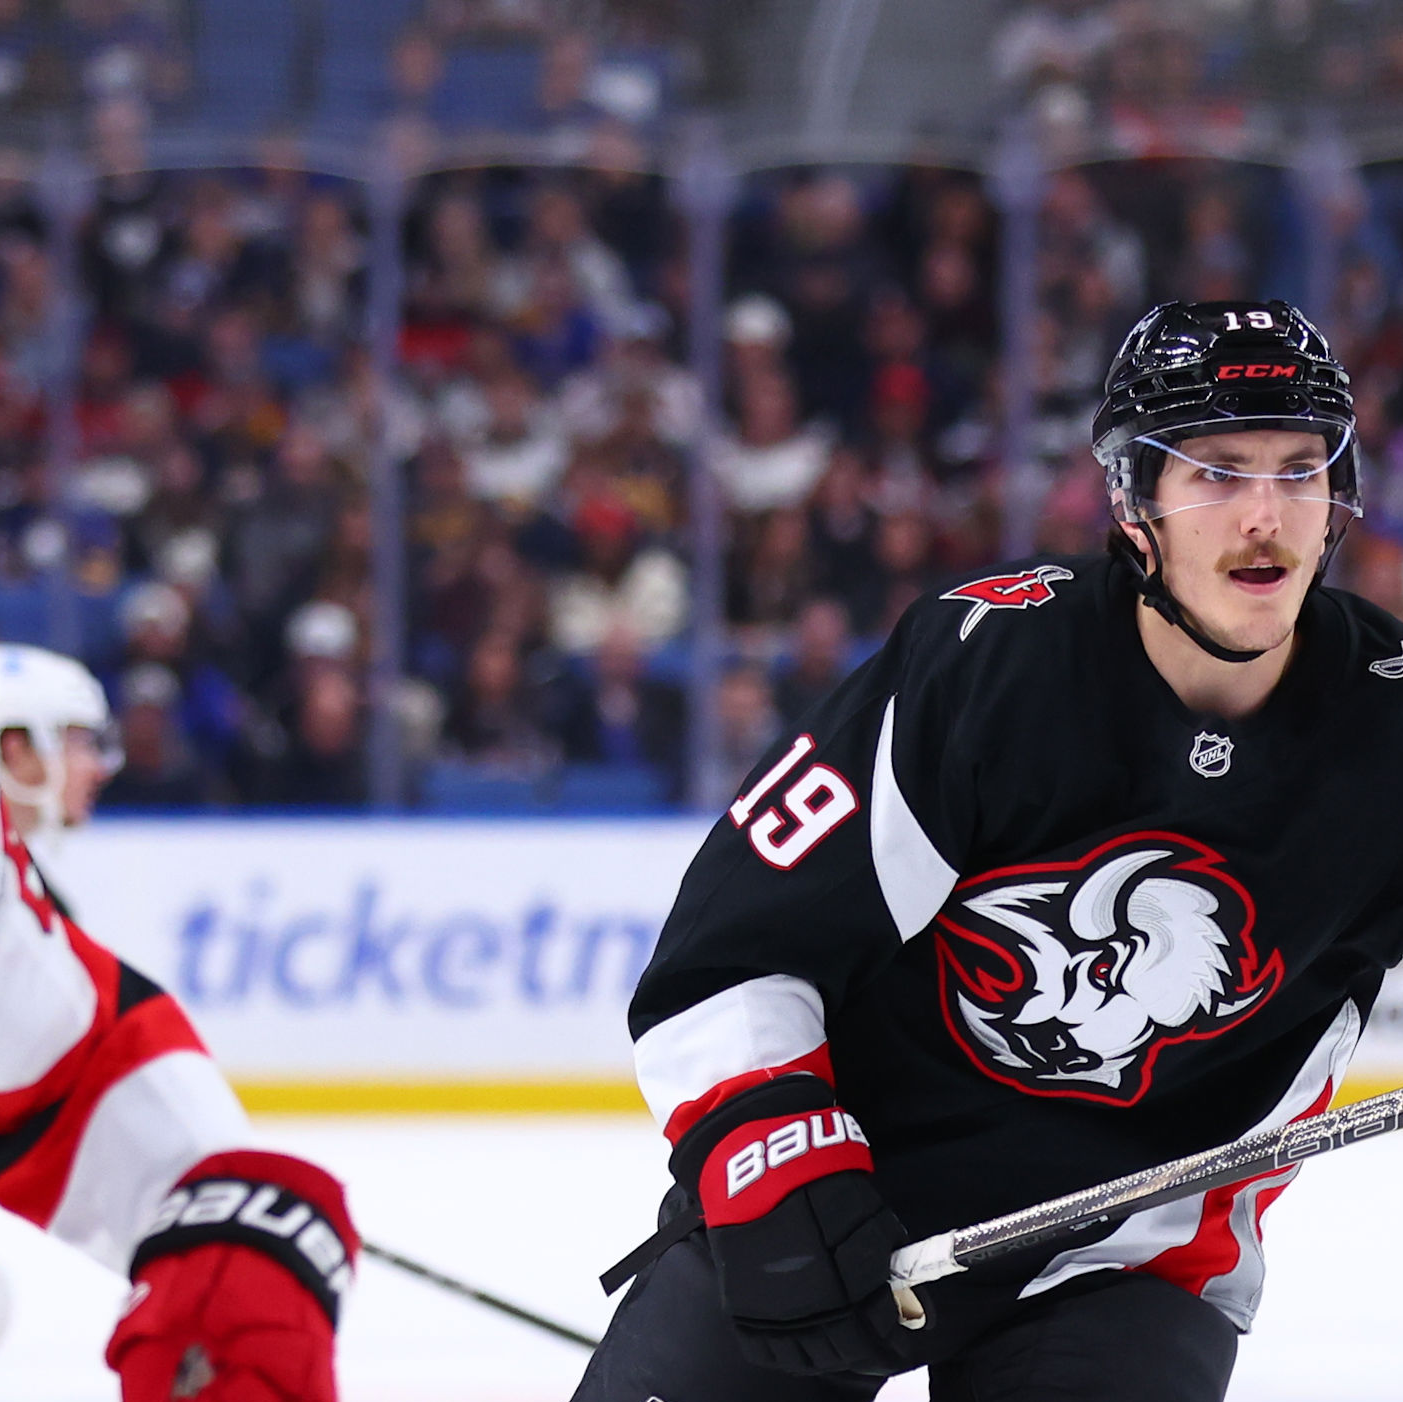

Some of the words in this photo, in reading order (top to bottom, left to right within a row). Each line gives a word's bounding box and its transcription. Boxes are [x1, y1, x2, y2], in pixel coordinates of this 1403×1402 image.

[1222, 310, 1275, 332] 19
[1216, 364, 1298, 380] CCM
[1199, 748, 1225, 766] NHL
[727, 732, 861, 871] 19
[725, 1109, 871, 1200] BAUE
